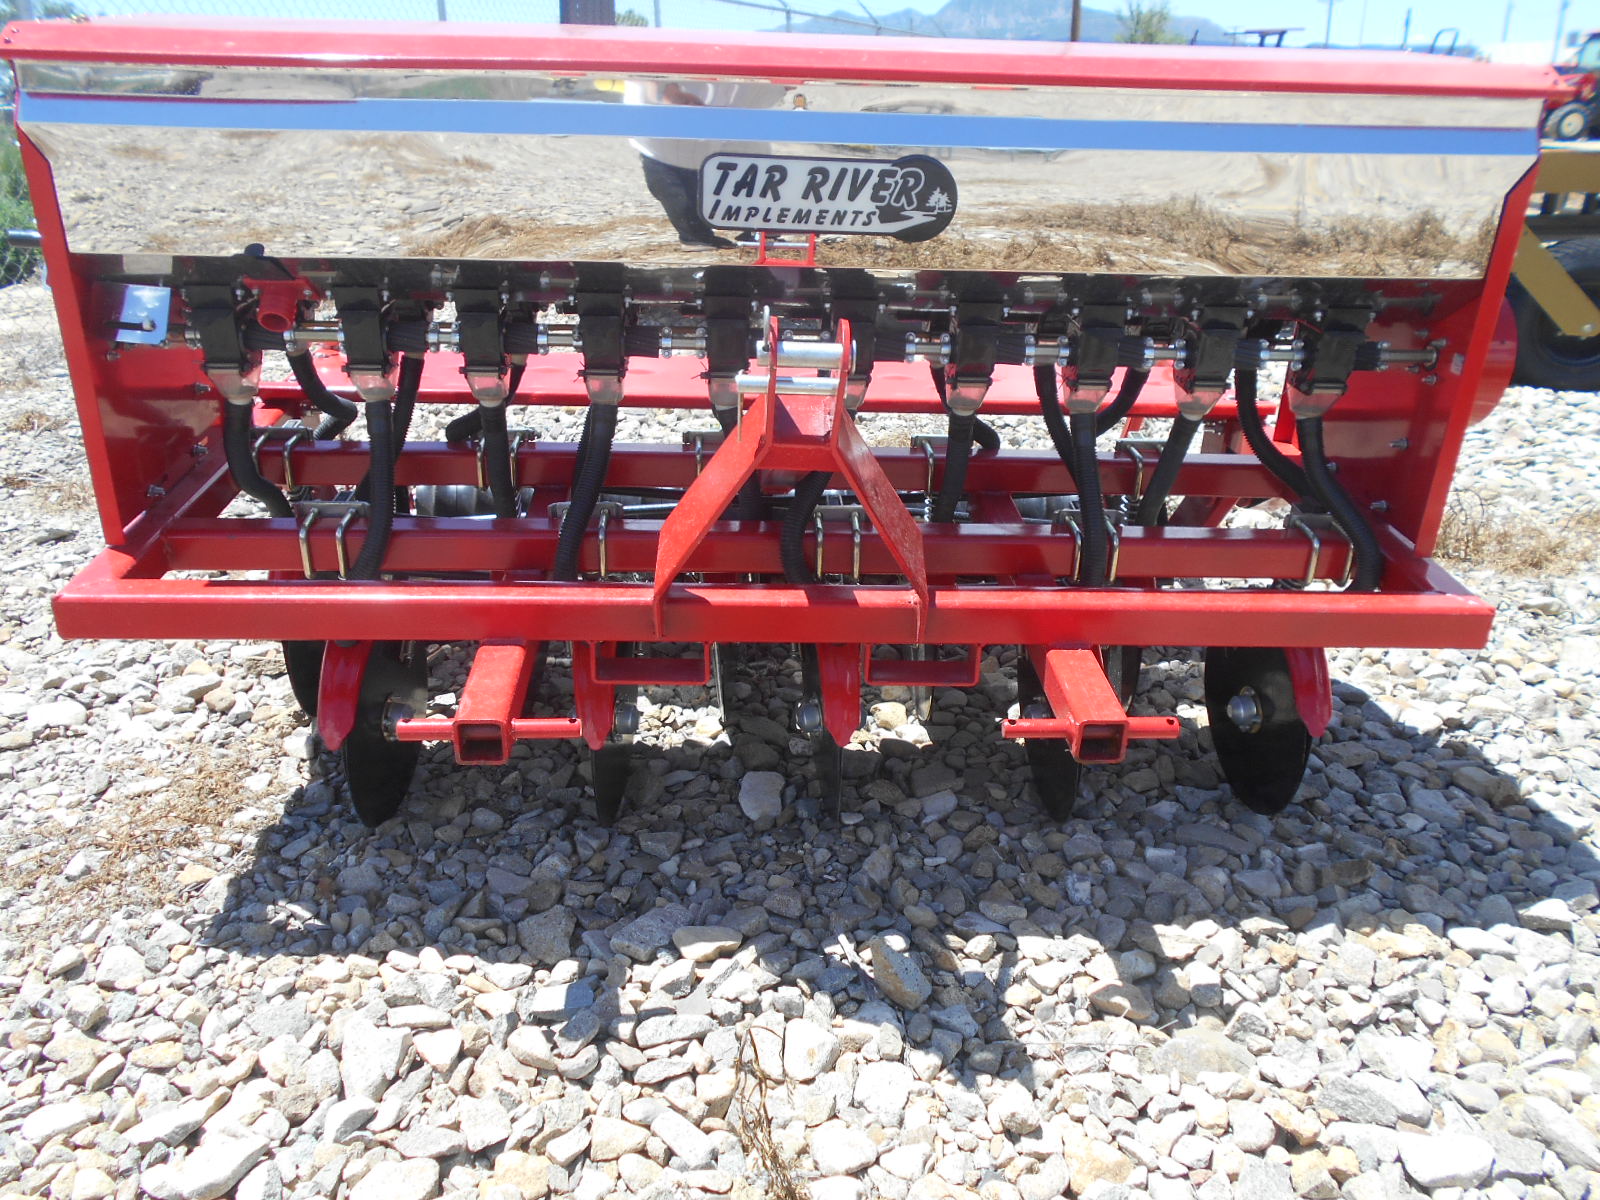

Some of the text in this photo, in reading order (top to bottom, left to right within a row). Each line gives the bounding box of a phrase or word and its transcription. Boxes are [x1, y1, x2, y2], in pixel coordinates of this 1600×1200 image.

[713, 161, 924, 210] TAR RIVER
[708, 199, 877, 227] IMPLEMENTS
